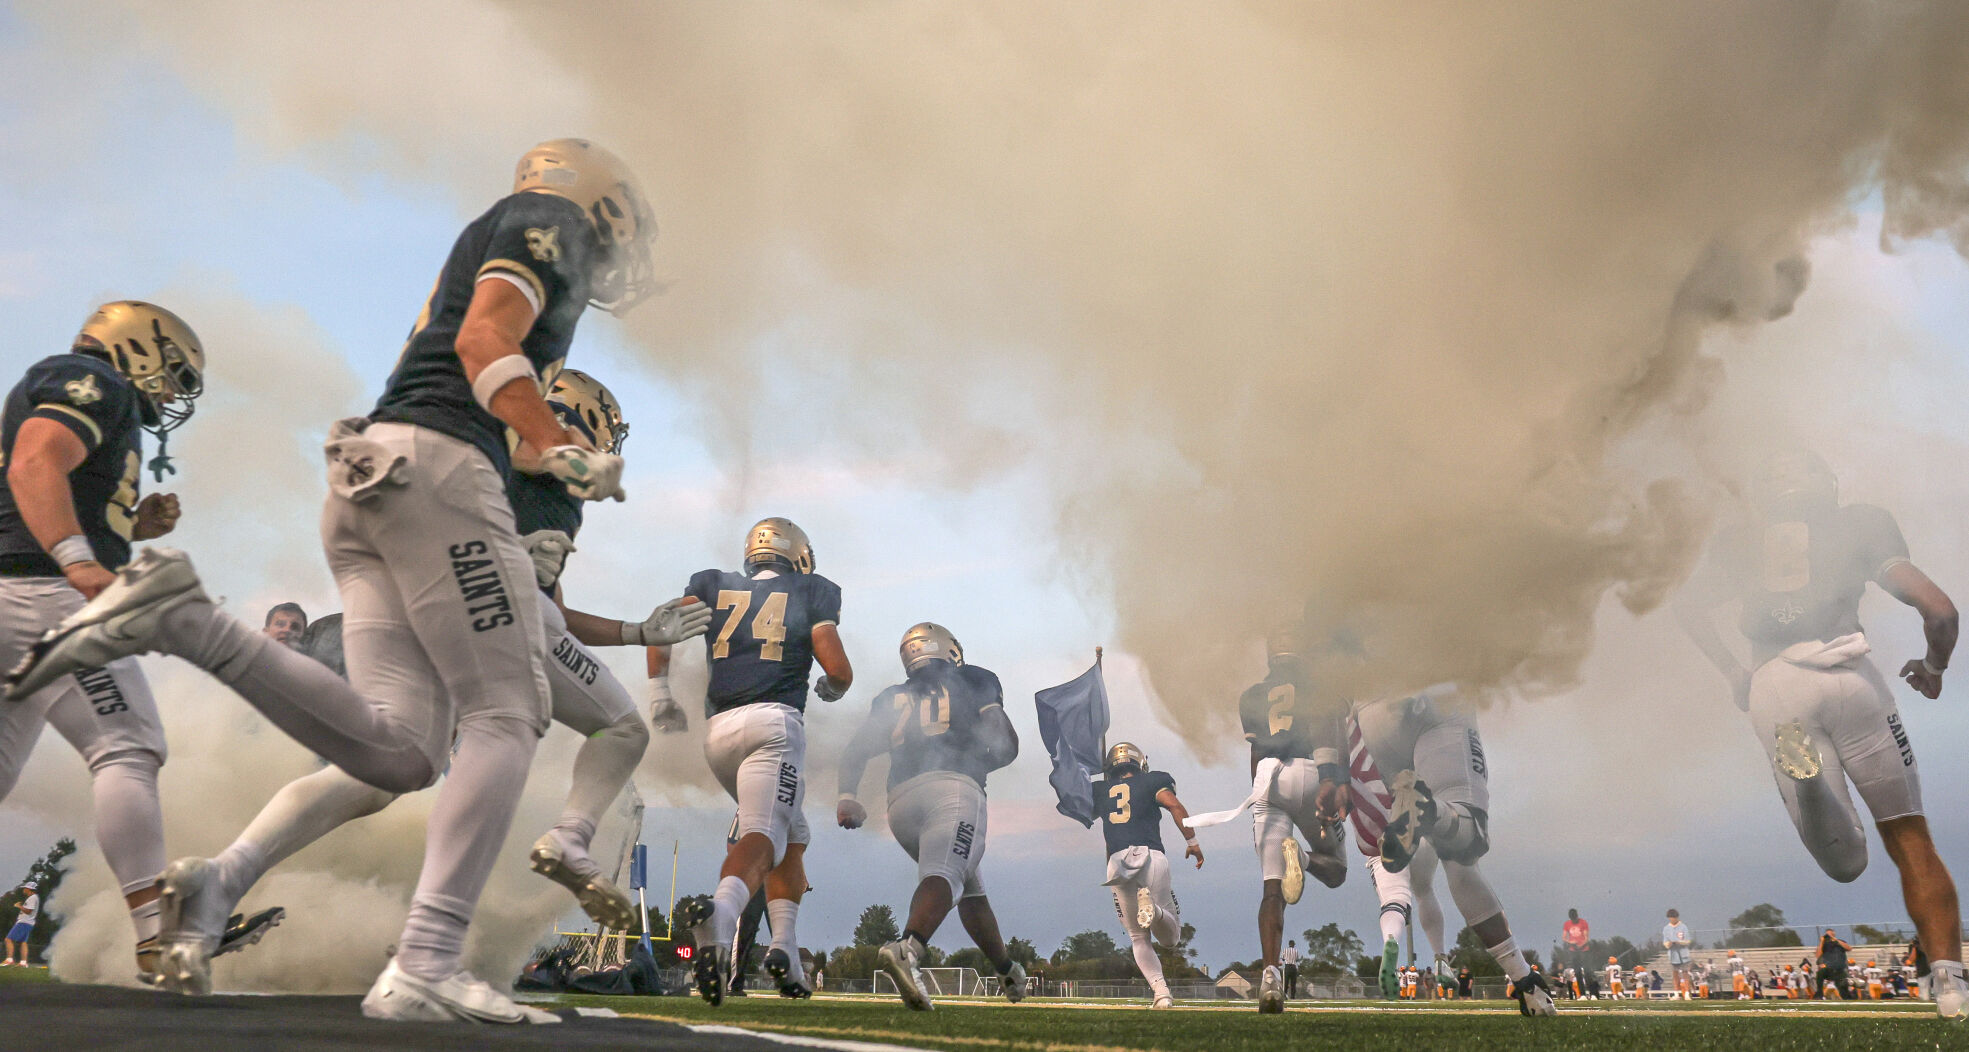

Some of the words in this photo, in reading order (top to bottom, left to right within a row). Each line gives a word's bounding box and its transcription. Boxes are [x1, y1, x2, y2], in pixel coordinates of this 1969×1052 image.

[448, 540, 514, 633] SAINTS
[711, 589, 789, 662] 74
[553, 637, 600, 686] SAINTS
[74, 664, 128, 716] AINTS
[1268, 683, 1295, 737] 2
[892, 686, 950, 746] 70
[1887, 713, 1913, 767] SAINTS
[777, 762, 798, 807] SAINTS
[1108, 783, 1131, 824] 3
[953, 821, 975, 860] SAINTS
[676, 946, 692, 959] 40
[1613, 969, 1622, 979] 2
